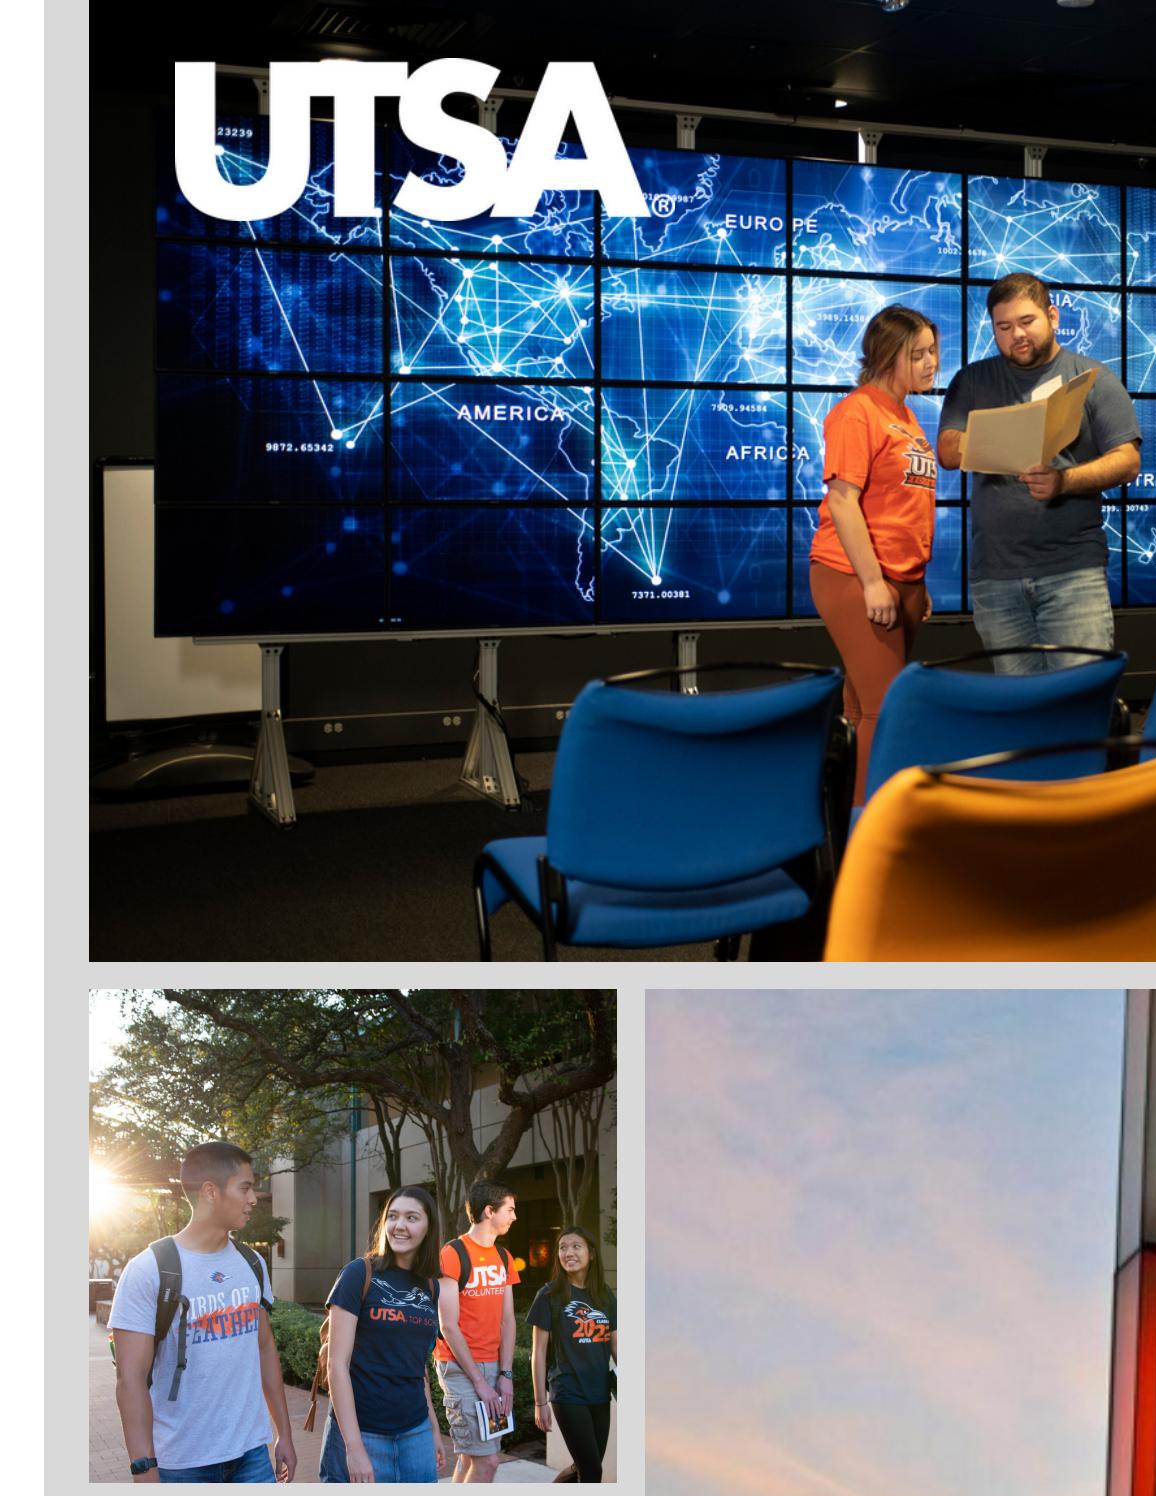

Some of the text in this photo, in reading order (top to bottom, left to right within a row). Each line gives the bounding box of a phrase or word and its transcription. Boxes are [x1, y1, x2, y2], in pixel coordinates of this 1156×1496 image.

[457, 404, 565, 421] AMERICA
[631, 590, 690, 599] 7371.00381
[187, 1291, 226, 1321] IRDS
[232, 1287, 250, 1309] OF
[370, 1307, 406, 1323] UTSA
